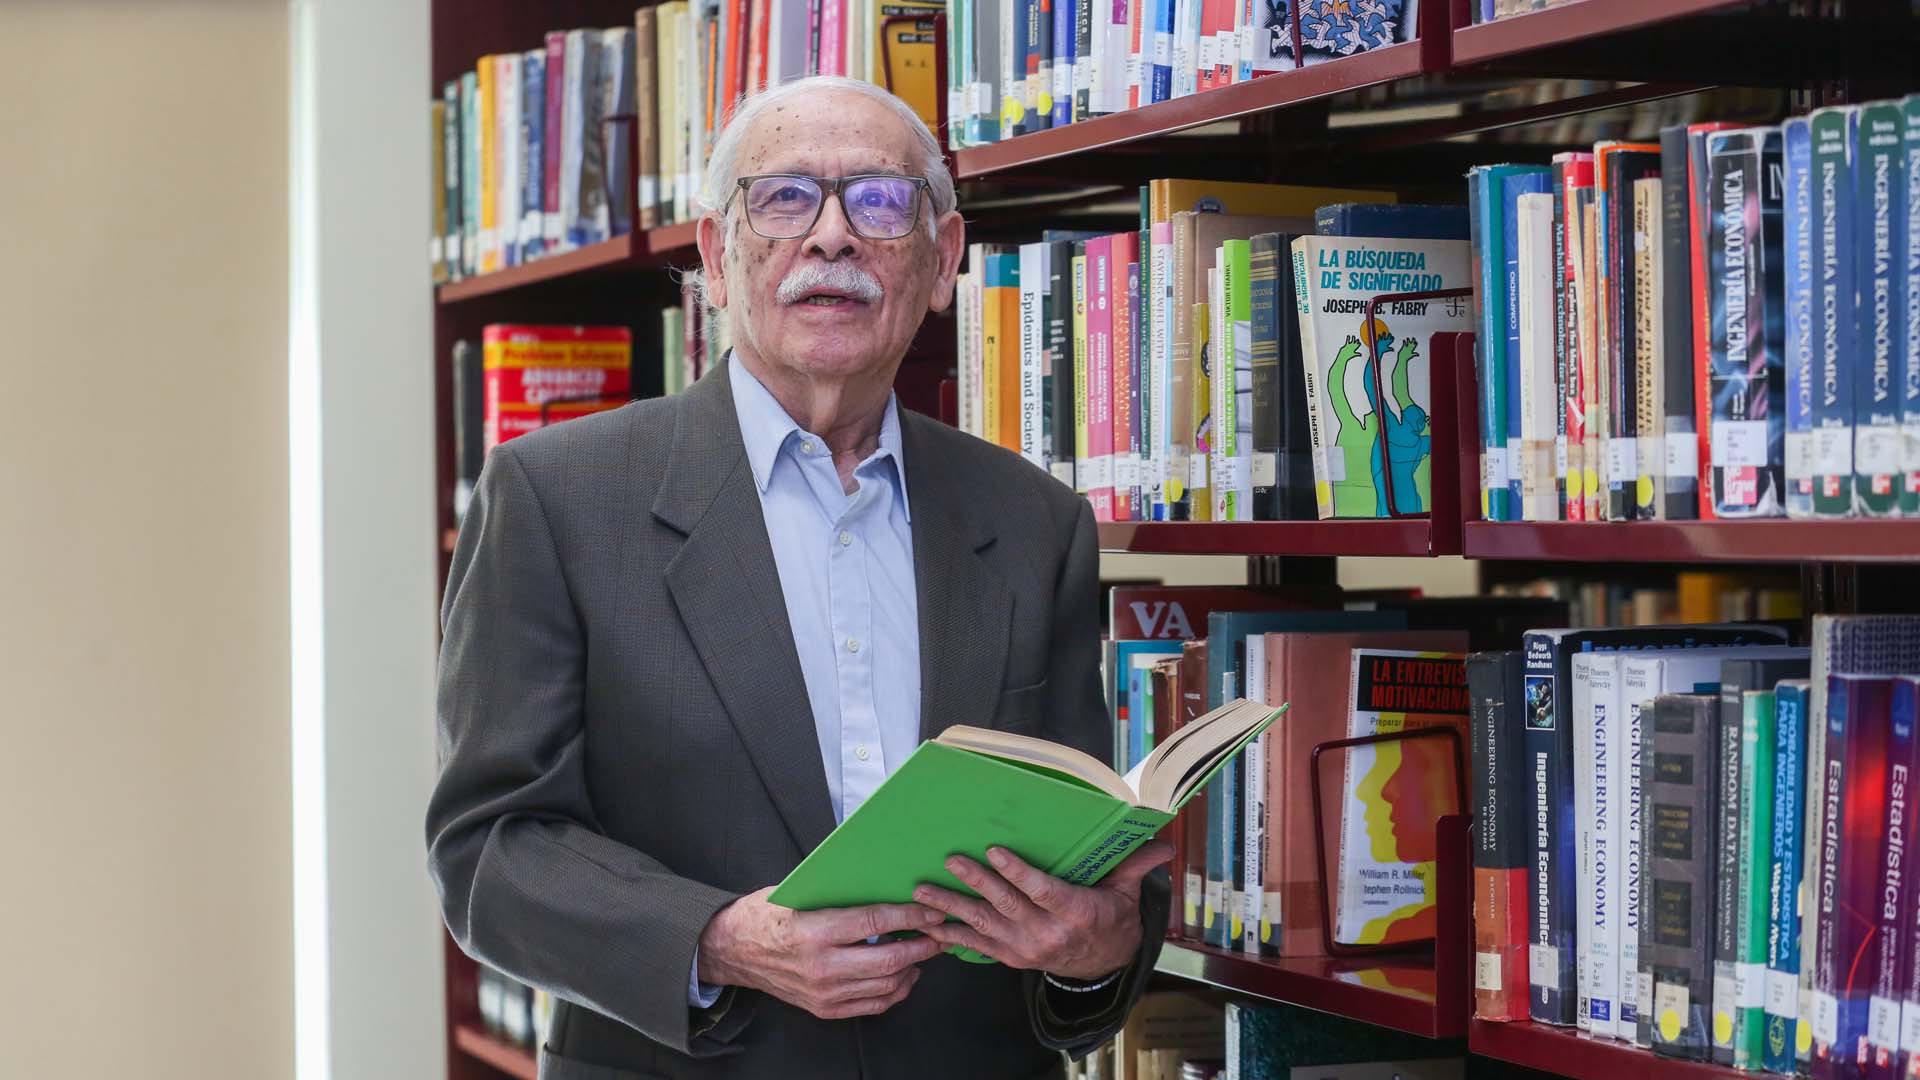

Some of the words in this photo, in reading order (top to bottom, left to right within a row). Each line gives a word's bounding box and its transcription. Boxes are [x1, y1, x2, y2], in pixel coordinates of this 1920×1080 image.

[1724, 169, 1744, 267] ECONÓMICA
[1797, 168, 1810, 282] INGENIERÍA
[1822, 162, 1837, 280] INGENIERÍA
[1873, 154, 1891, 273] INGENIERÍA
[1298, 251, 1309, 301] SIGNIFICADO
[1319, 249, 1339, 268] LA
[1345, 245, 1426, 272] BÚSQUEDA
[1321, 271, 1341, 289] DE
[1348, 271, 1443, 292] SIGNIFICADO
[1556, 225, 1564, 292] Marshaling
[1023, 292, 1035, 368] Epidemics
[1303, 304, 1309, 314] DE
[1323, 299, 1370, 314] JOSEPH
[1375, 302, 1386, 315] B.
[1391, 301, 1429, 316] FABRY
[1556, 296, 1565, 366] Technology
[1567, 281, 1575, 328] Exploring
[1726, 268, 1747, 362] INGENIERÍA
[1799, 289, 1812, 417] ECONÓMICA
[1823, 284, 1838, 407] ECONÓMICA
[1873, 277, 1891, 402] ECONÓMICA
[1024, 373, 1035, 398] and
[1307, 372, 1315, 398] FABRY
[1022, 402, 1035, 456] Society
[1311, 415, 1319, 448] JOSEPH
[1129, 601, 1195, 638] VA
[1533, 642, 1547, 651] Riggs
[1372, 659, 1390, 683] LA
[1397, 659, 1466, 684] ENTREVIS
[1527, 651, 1552, 660] Bedworth
[1486, 698, 1497, 784] ENGINEERING
[1777, 699, 1788, 747] PARA
[1593, 704, 1606, 831] ENGINEERING
[1629, 704, 1640, 831] ENGINEERING
[1727, 726, 1738, 809] RANDOM
[1785, 702, 1797, 832] PROBABILIDAD
[1488, 789, 1497, 852] ECONOMY
[1536, 752, 1548, 848] Ingeniería
[1774, 753, 1786, 857] INGENIEROS
[1726, 815, 1737, 874] DATA:
[1785, 836, 1792, 847] Y
[1823, 760, 1841, 913] Estadística
[1884, 764, 1907, 921] Estadística
[1364, 885, 1391, 896] tephen
[1393, 884, 1426, 895] Rollnick
[1392, 870, 1399, 879] R.
[1594, 838, 1606, 930] ECONOMY
[1627, 839, 1639, 931] ECONOMY
[1724, 877, 1732, 926] ANALYSIS
[1771, 862, 1782, 920] Walpole
[1781, 850, 1792, 959] ESTADISTICA
[1770, 923, 1779, 968] Myers
